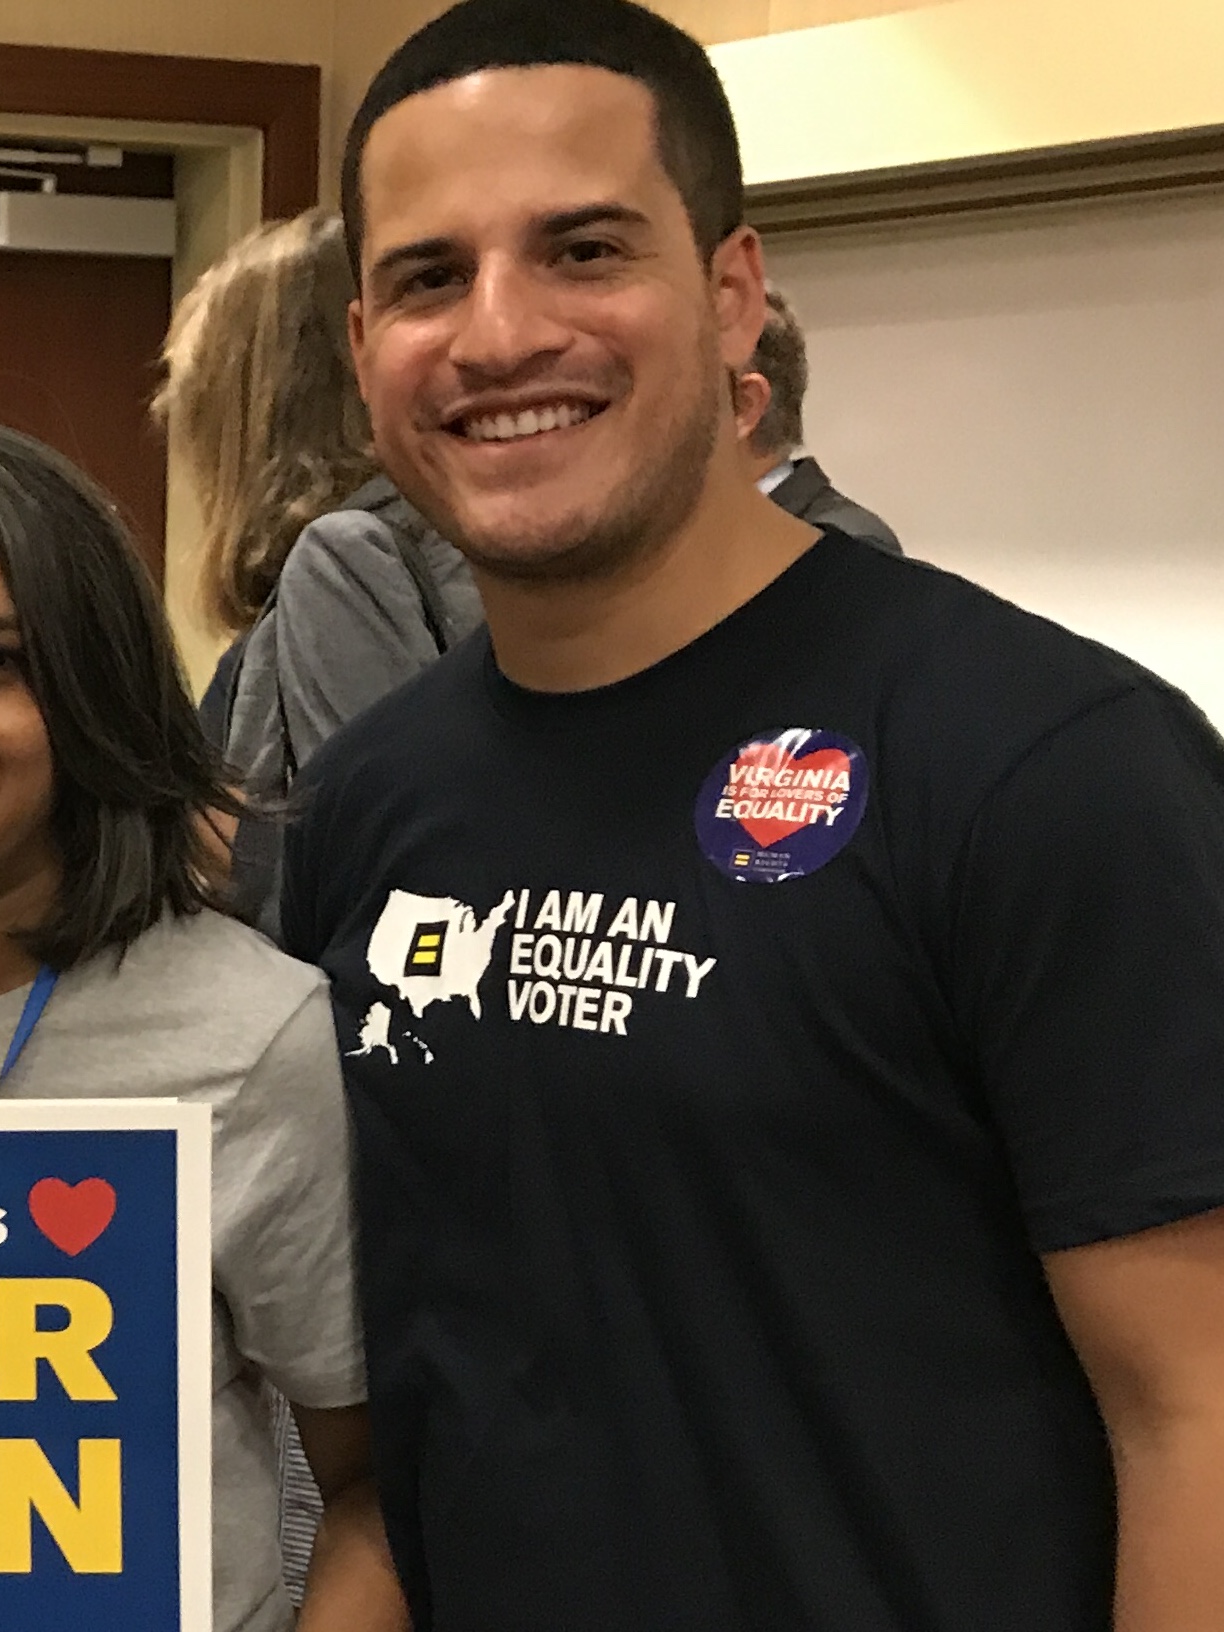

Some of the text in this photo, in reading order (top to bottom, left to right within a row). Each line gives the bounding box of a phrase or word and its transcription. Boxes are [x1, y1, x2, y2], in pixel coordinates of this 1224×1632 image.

[721, 785, 849, 804] IS FOR LOVERS OF
[729, 764, 851, 791] VIRGINIA
[715, 798, 845, 826] EQUALITY
[514, 888, 676, 944] I AM AN
[509, 933, 718, 999] EQUALITY
[507, 979, 633, 1036] VOTER
